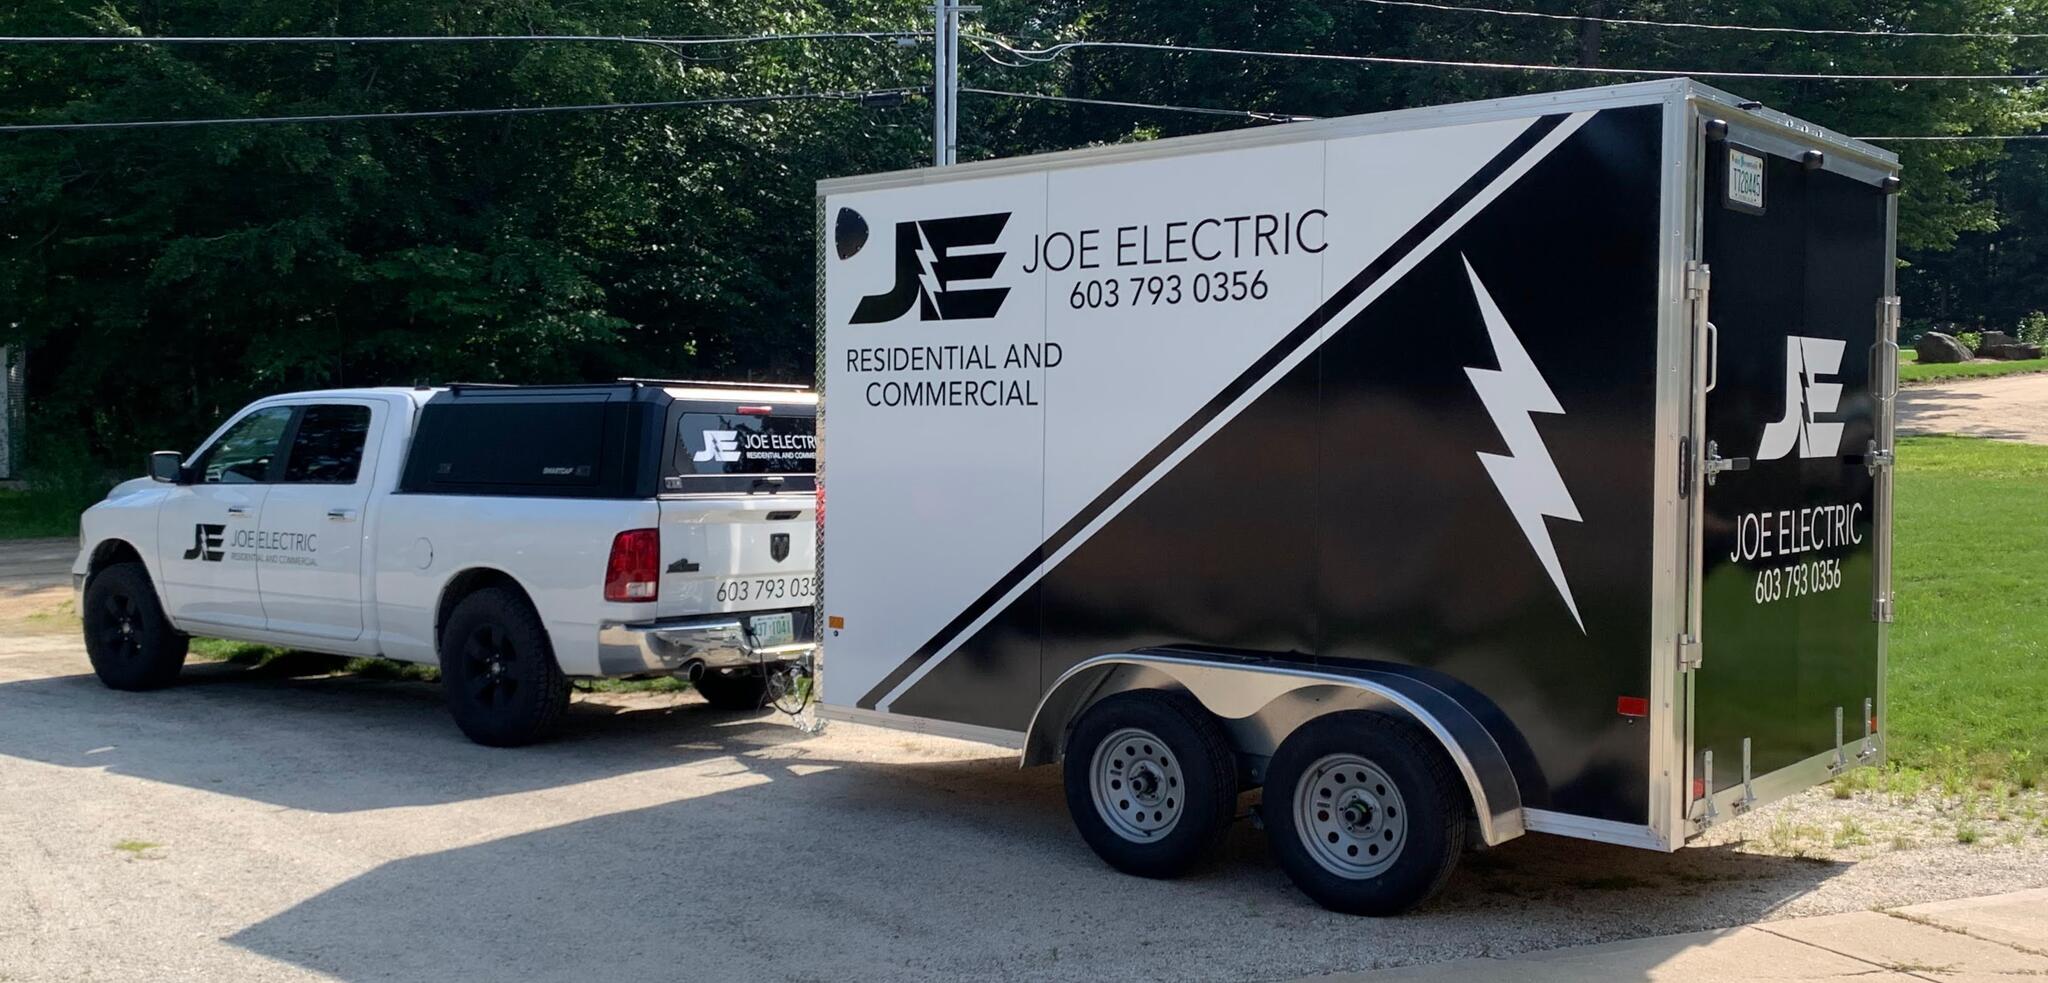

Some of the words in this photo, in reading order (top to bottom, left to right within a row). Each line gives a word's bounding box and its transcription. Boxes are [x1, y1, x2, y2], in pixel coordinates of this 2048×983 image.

[1022, 229, 1100, 274] JOE
[1117, 209, 1329, 266] ELECTRIC
[848, 211, 1012, 325] JE
[1070, 280, 1120, 309] 603
[1130, 275, 1182, 306] 793
[1194, 269, 1268, 303] 0356
[846, 345, 996, 373] RESIDENTIAL
[1004, 342, 1063, 369] AND
[865, 380, 1039, 407] COMMERCIAL
[1756, 335, 1847, 460] JE
[693, 430, 741, 461] JE
[744, 434, 770, 449] JOE
[746, 451, 782, 459] RESIDENTIAL
[782, 451, 794, 459] AND
[183, 523, 227, 562] JE
[230, 530, 255, 548] JOE
[258, 531, 317, 552] ELECTRIC
[1730, 512, 1772, 563] JOE
[1779, 502, 1863, 555] ELECTRIC
[717, 581, 748, 602] 603
[755, 579, 785, 599] 793
[790, 577, 817, 598] 035
[1755, 568, 1781, 604] 603
[1785, 563, 1808, 598] 793
[1811, 558, 1841, 594] 0356
